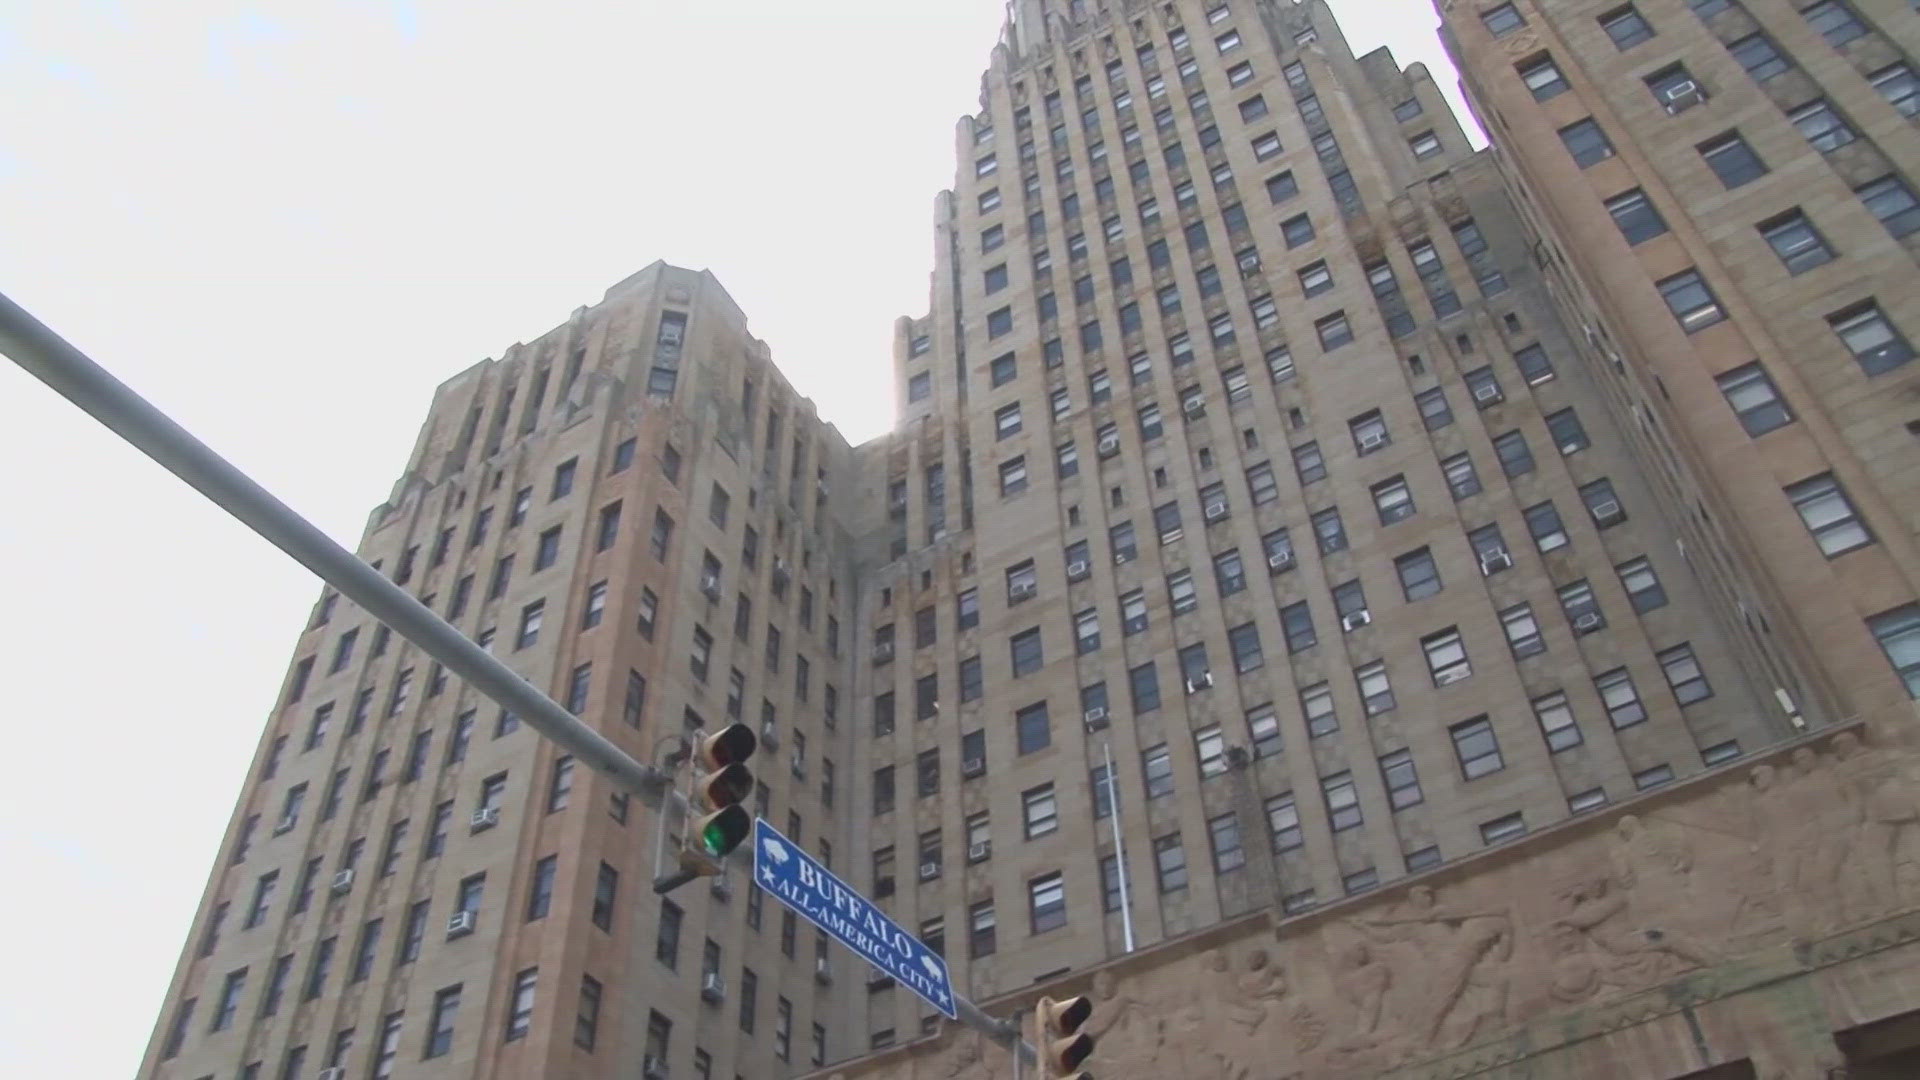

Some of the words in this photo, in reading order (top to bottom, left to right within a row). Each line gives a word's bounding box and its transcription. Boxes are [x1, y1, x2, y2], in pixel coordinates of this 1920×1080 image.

[778, 878, 895, 970] ALL-AMERICA
[899, 962, 934, 996] CITY
[797, 856, 912, 959] BUFFALO
